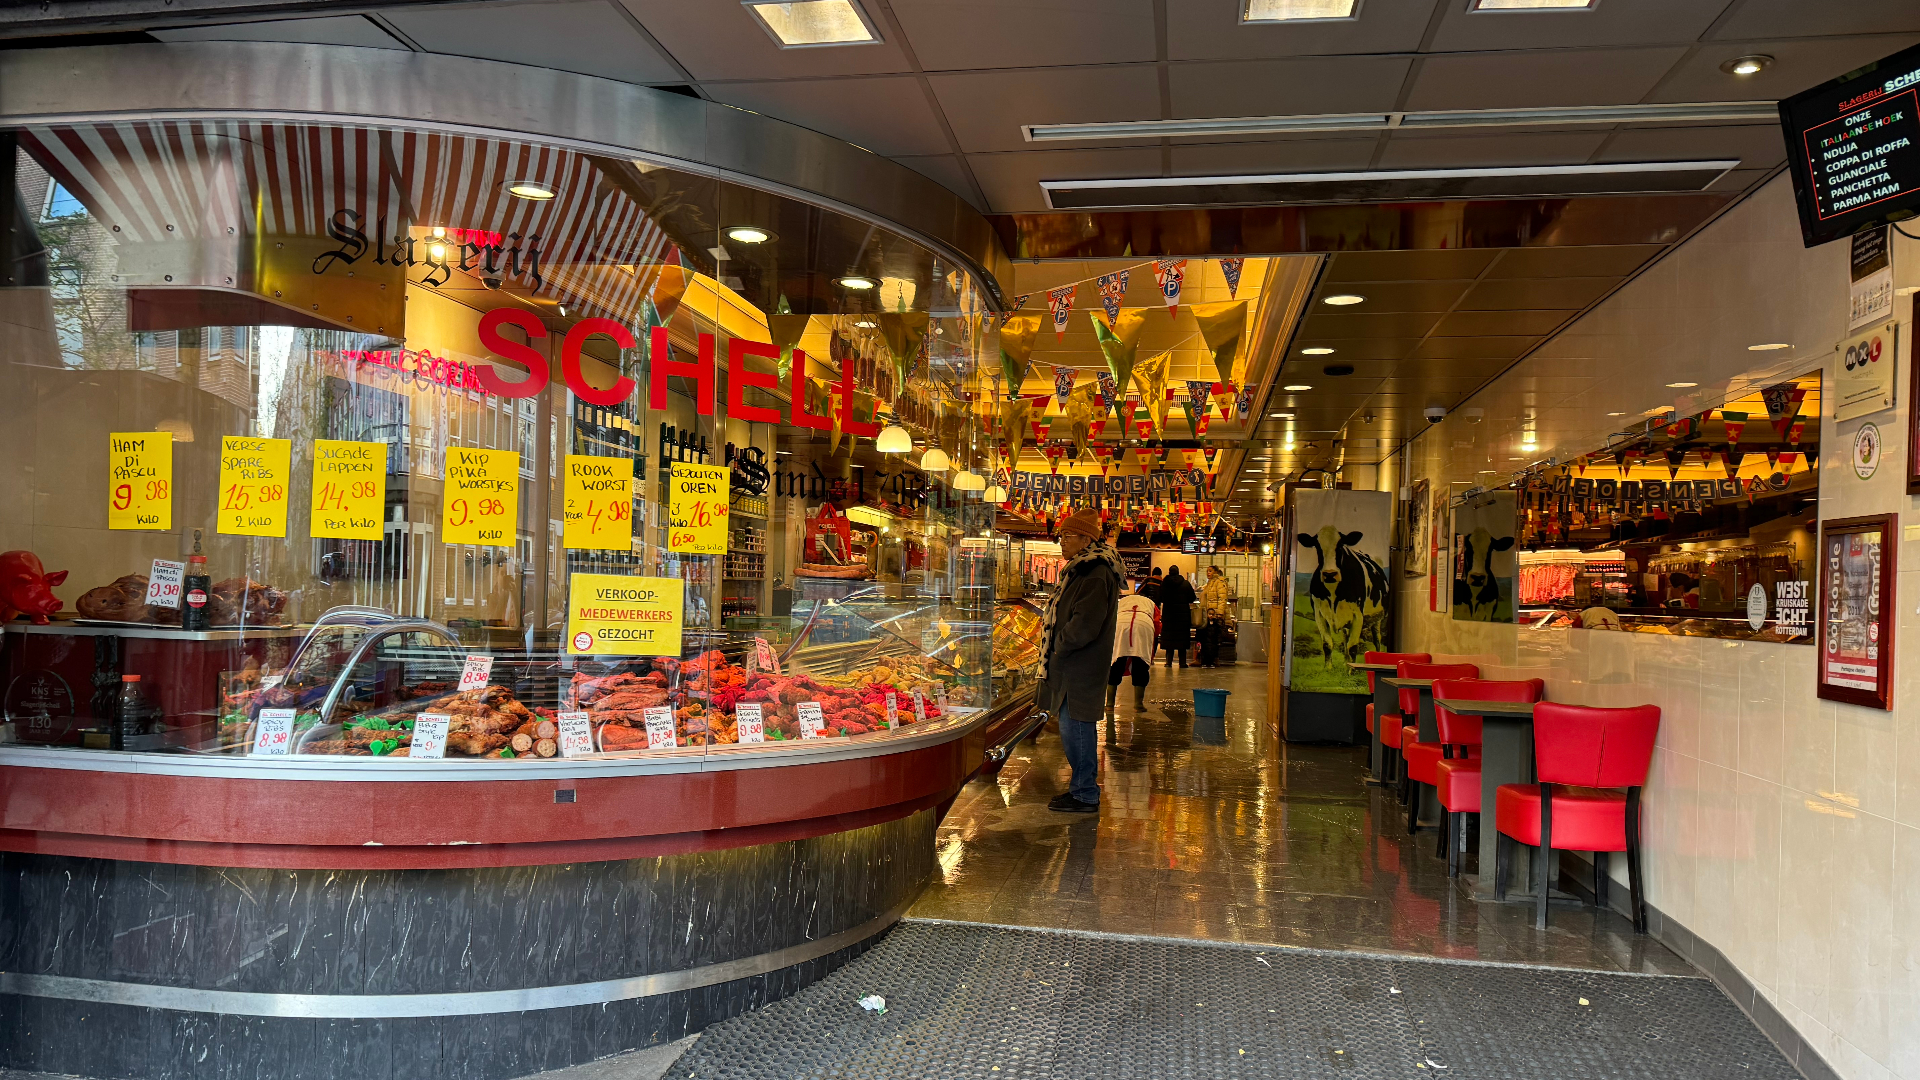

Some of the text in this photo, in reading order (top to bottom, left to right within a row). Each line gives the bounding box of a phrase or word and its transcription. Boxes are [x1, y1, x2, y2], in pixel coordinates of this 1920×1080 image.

[1838, 87, 1883, 110] SLAGERIJ
[1845, 110, 1872, 127] ONZE
[1820, 111, 1904, 148] ITALIAANSE HOEK
[1823, 142, 1859, 160] NDUJA
[1826, 137, 1911, 173] COPPA DI ROFFA
[1828, 159, 1888, 186] GUANCIALE
[1831, 172, 1891, 199] PANCHETTA
[1833, 183, 1900, 212] PARMA HAM
[312, 208, 543, 296] Slagerij
[1845, 342, 1880, 367] MXL
[477, 308, 882, 438] SCHELL
[113, 439, 144, 452] HAM
[225, 441, 266, 451] VERSE
[222, 457, 264, 470] SPARE
[320, 461, 373, 474] LAPPEN
[572, 463, 614, 477] ROOK
[671, 465, 723, 480] GEZOUTEN
[582, 479, 628, 491] WORST
[681, 482, 717, 494] OREN
[1015, 472, 1165, 493] PENSIOEN
[222, 484, 283, 510] 15.98
[567, 499, 575, 508] 2
[235, 516, 246, 527] 2
[324, 519, 346, 529] PER
[596, 589, 659, 600] VERKOOP-
[1776, 580, 1809, 599] WEST
[1776, 599, 1809, 608] KRUISKADE
[1829, 542, 1842, 654] Oorkonde
[580, 608, 673, 620] MEDEWERKERS
[1775, 608, 1809, 626] ECHT
[598, 629, 654, 639] GEZOCHT
[1775, 626, 1808, 637] ROTTERDAM
[28, 716, 52, 729] 130
